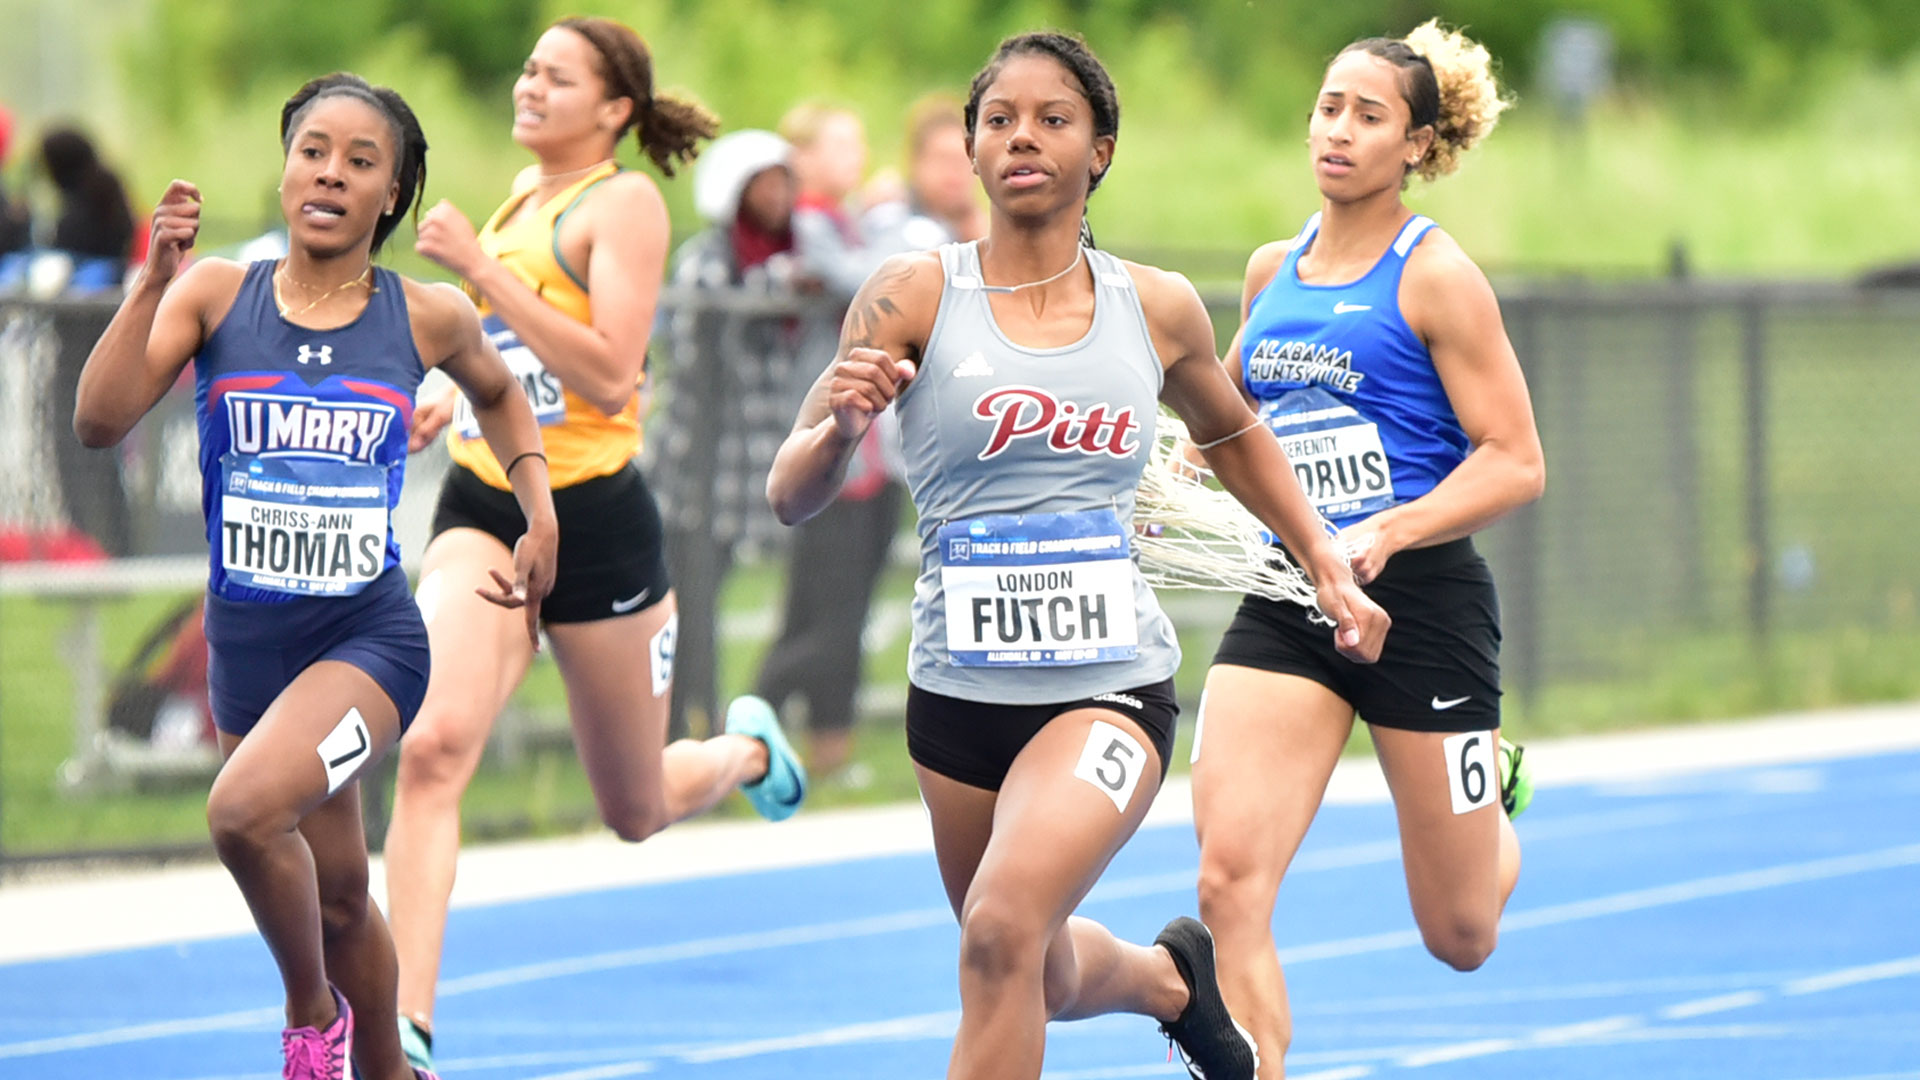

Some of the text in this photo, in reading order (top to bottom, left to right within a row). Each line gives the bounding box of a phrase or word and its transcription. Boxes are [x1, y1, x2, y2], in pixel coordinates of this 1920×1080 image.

[1250, 362, 1365, 393] HUNTSVILLE
[1251, 340, 1352, 370] ALABAMA
[973, 384, 1141, 460] Pitt
[251, 507, 353, 530] CHRISS-ANN
[224, 521, 380, 578] THOMAS
[971, 542, 1000, 555] TRACK
[1010, 540, 1037, 555] FIELD
[997, 570, 1073, 593] LONDON
[972, 594, 1108, 643] FUTCH
[329, 724, 367, 770] 7
[1096, 738, 1134, 791] 5
[1461, 737, 1486, 804] 6
